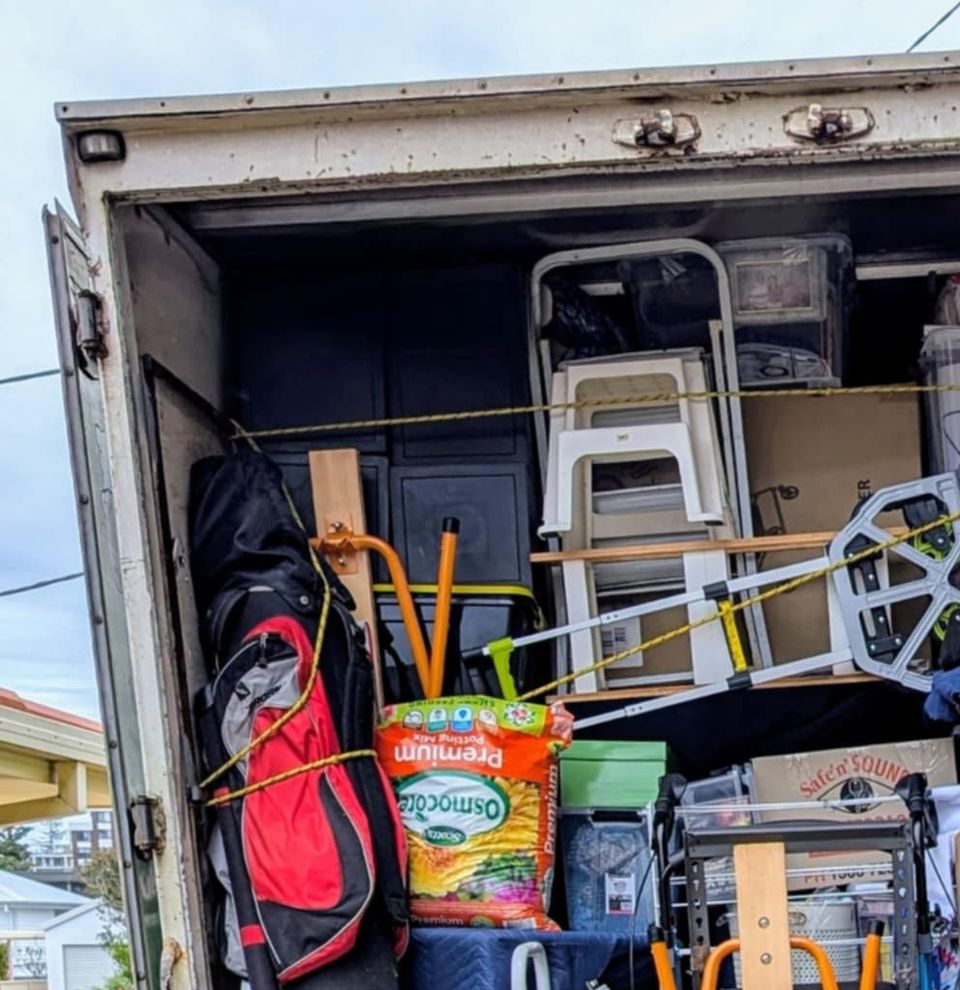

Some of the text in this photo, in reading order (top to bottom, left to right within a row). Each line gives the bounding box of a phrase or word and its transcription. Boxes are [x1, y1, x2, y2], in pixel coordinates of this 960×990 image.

[394, 744, 503, 769] Premium
[851, 754, 911, 782] SOUN
[544, 765, 559, 855] Premium
